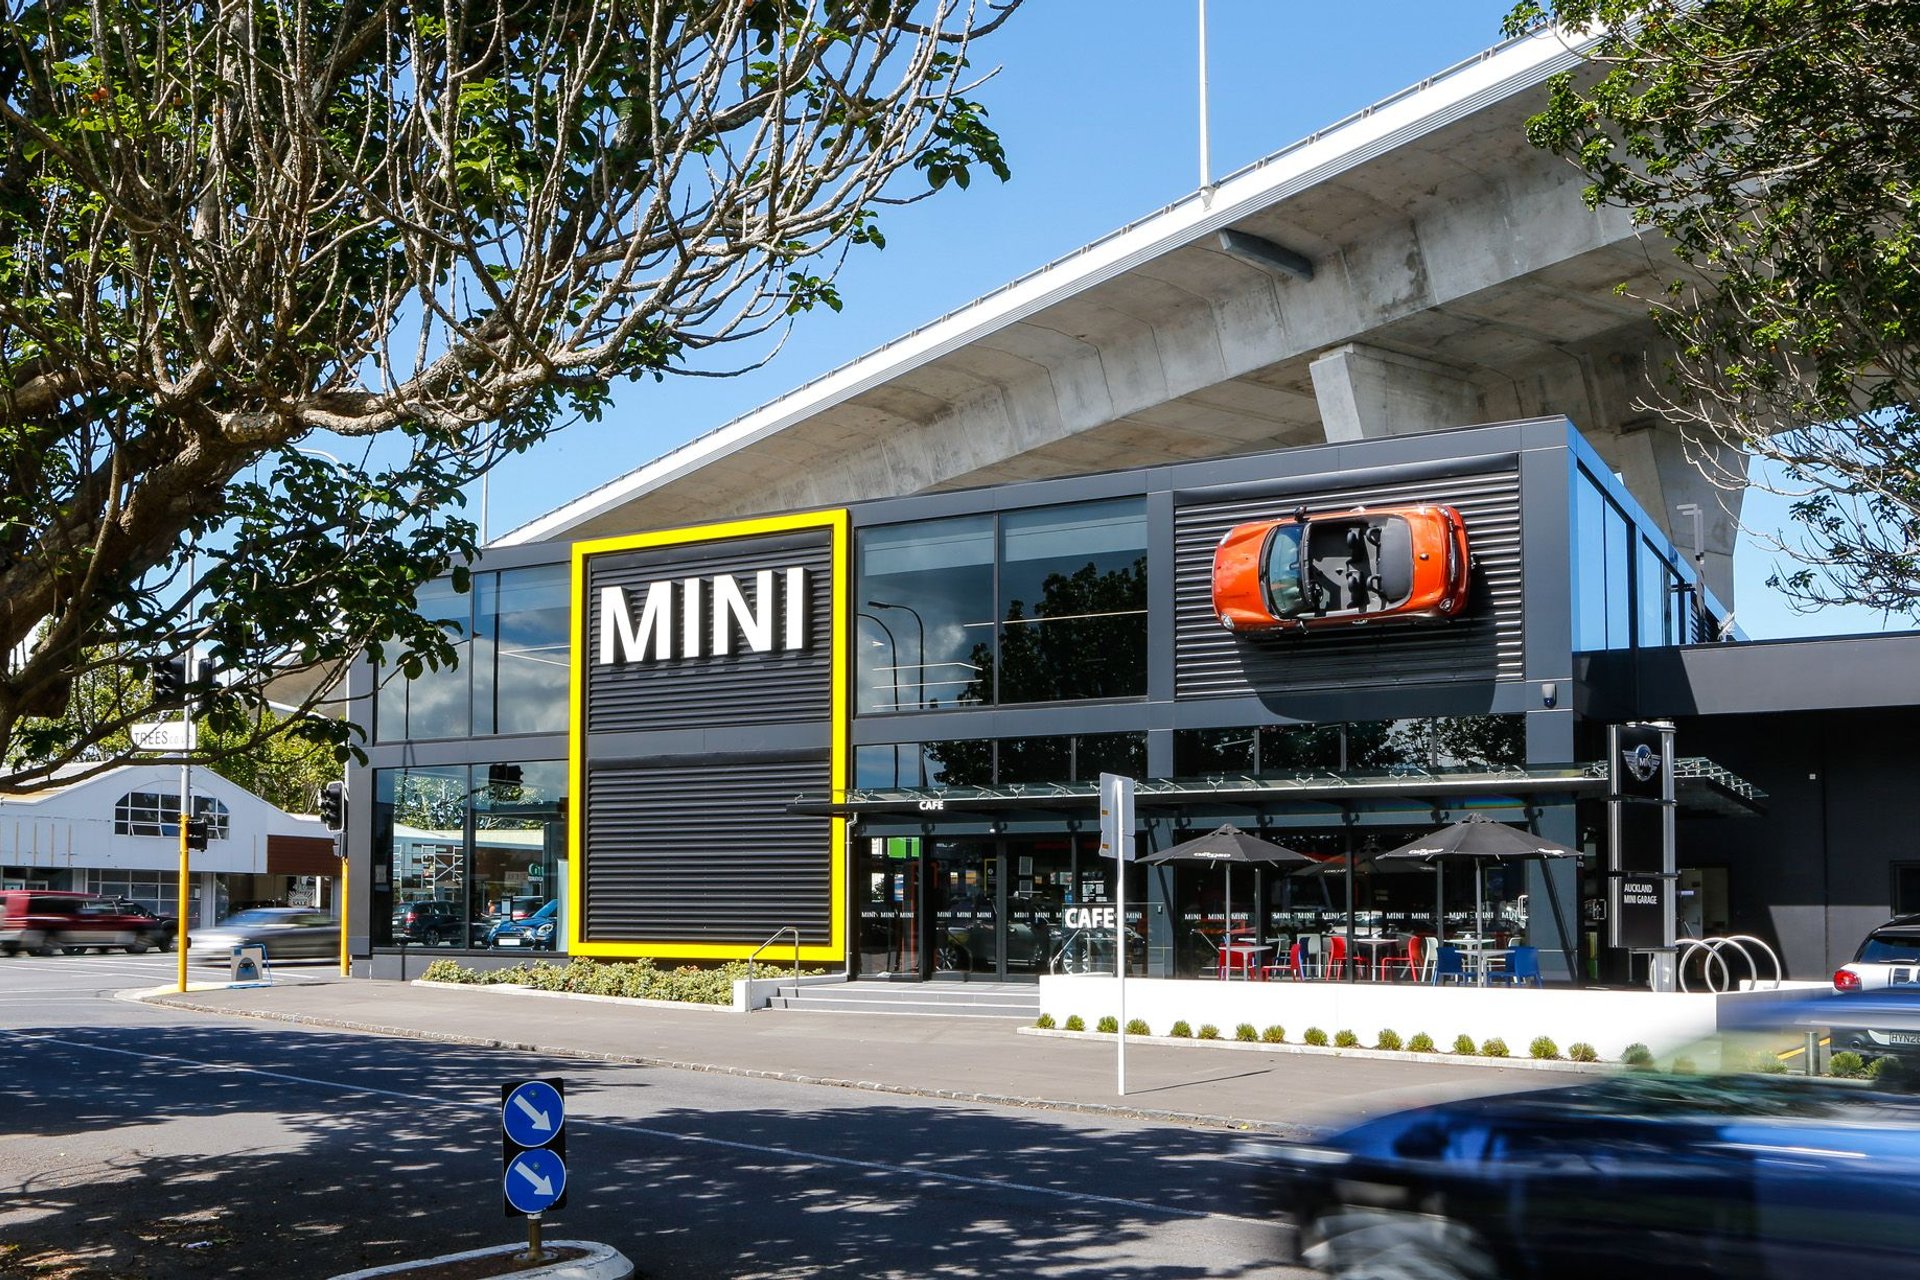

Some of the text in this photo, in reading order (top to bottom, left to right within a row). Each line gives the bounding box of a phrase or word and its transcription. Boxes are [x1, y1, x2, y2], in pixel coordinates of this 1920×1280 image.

[600, 566, 805, 665] MINI
[134, 730, 168, 745] TREES
[919, 800, 944, 810] CAFE
[1623, 883, 1653, 893] AUCKLAND
[1623, 894, 1657, 905] MINI GARAGE
[1064, 908, 1115, 928] CAFE
[1386, 912, 1405, 920] MINI
[1411, 912, 1430, 920] MINI
[1448, 911, 1468, 919] MINI
